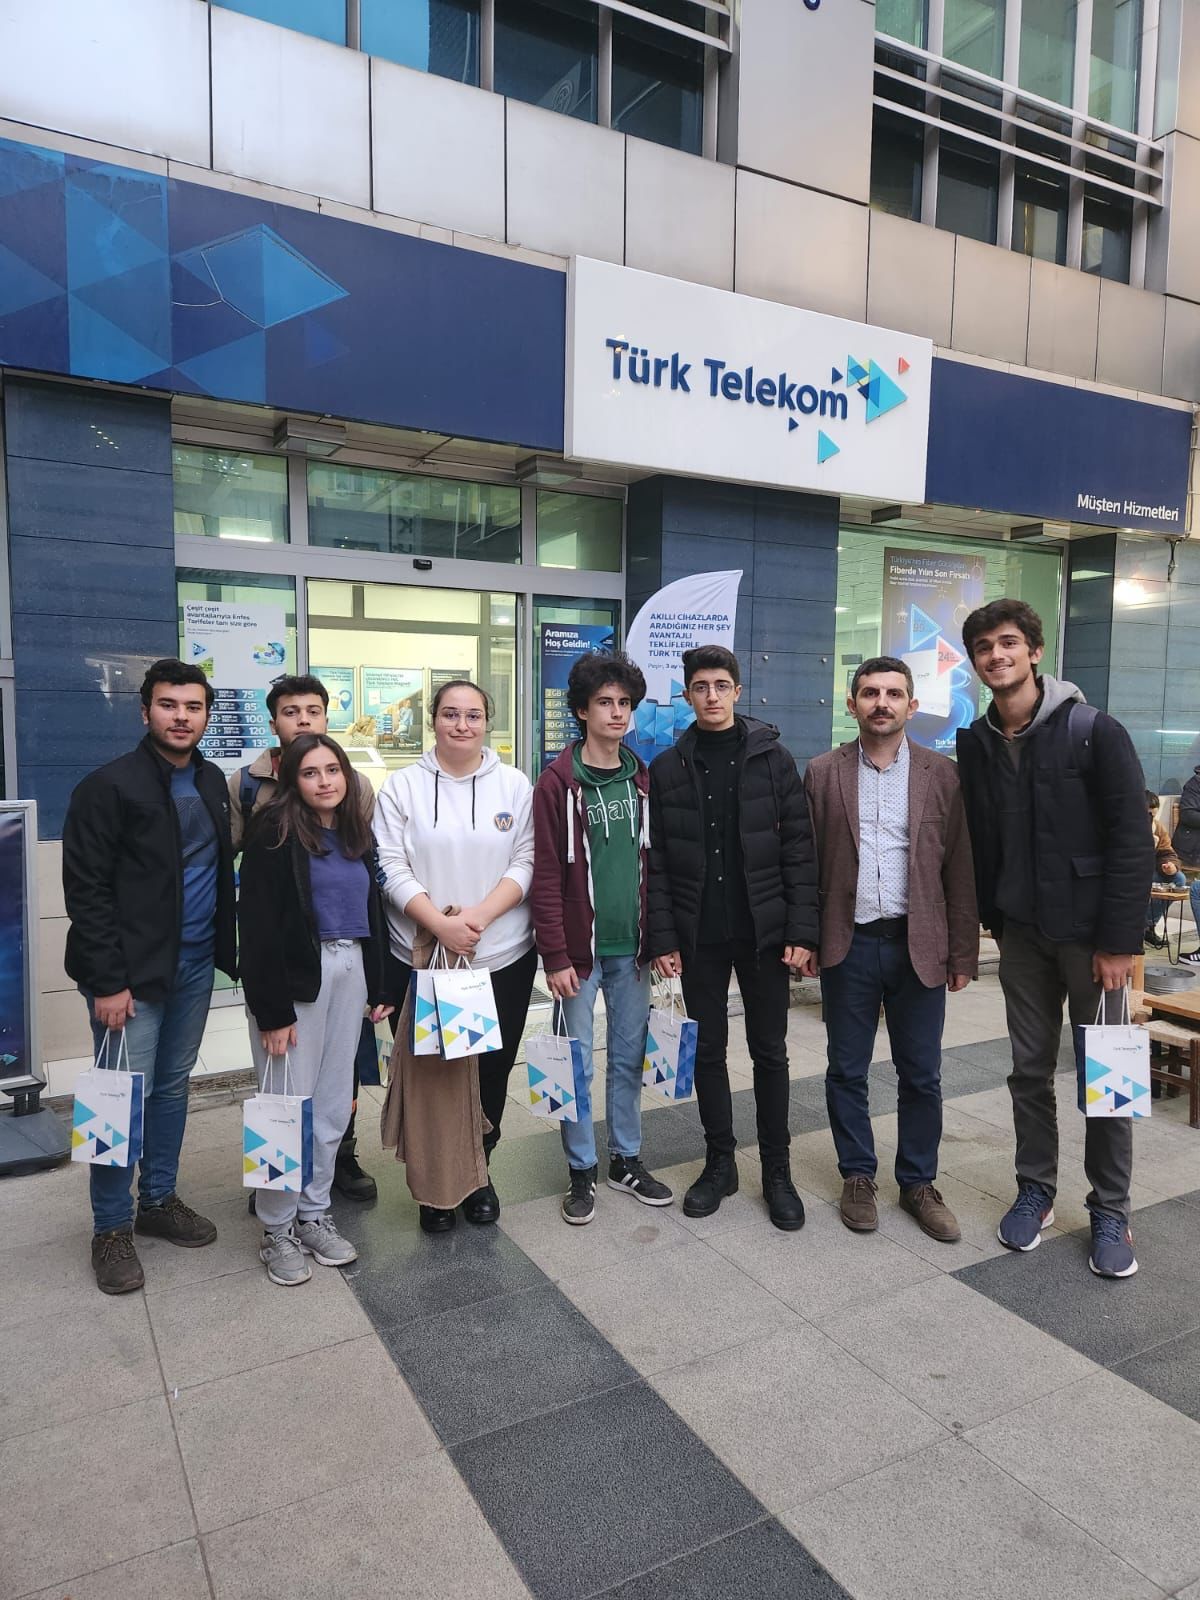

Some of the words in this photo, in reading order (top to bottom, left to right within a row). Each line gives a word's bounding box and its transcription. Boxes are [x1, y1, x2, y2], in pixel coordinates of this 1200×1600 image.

[606, 338, 691, 392] Türk
[704, 358, 848, 420] Telekom
[1077, 493, 1121, 514] Müşteri
[1123, 500, 1179, 521] Hizmetleri
[890, 565, 917, 576] Fiberde
[934, 569, 948, 578] Son
[650, 612, 676, 621] AKILLI
[677, 612, 729, 622] CİHAZLARDA
[649, 621, 697, 630] ARADIĞINIZ
[697, 623, 715, 631] HER
[715, 623, 732, 632] ŞEY
[544, 629, 579, 639] Aramıza
[649, 631, 693, 639] AVANTAJLI
[544, 638, 561, 649] Hoş
[561, 640, 591, 649] Geldin!
[649, 640, 701, 649] TEKLİFLERLE
[648, 649, 670, 657] TÜRK
[241, 690, 256, 699] 75
[244, 702, 257, 711] 85
[244, 714, 264, 724] 100
[248, 726, 266, 736] 120
[206, 739, 220, 747] GB
[252, 738, 269, 748] 135
